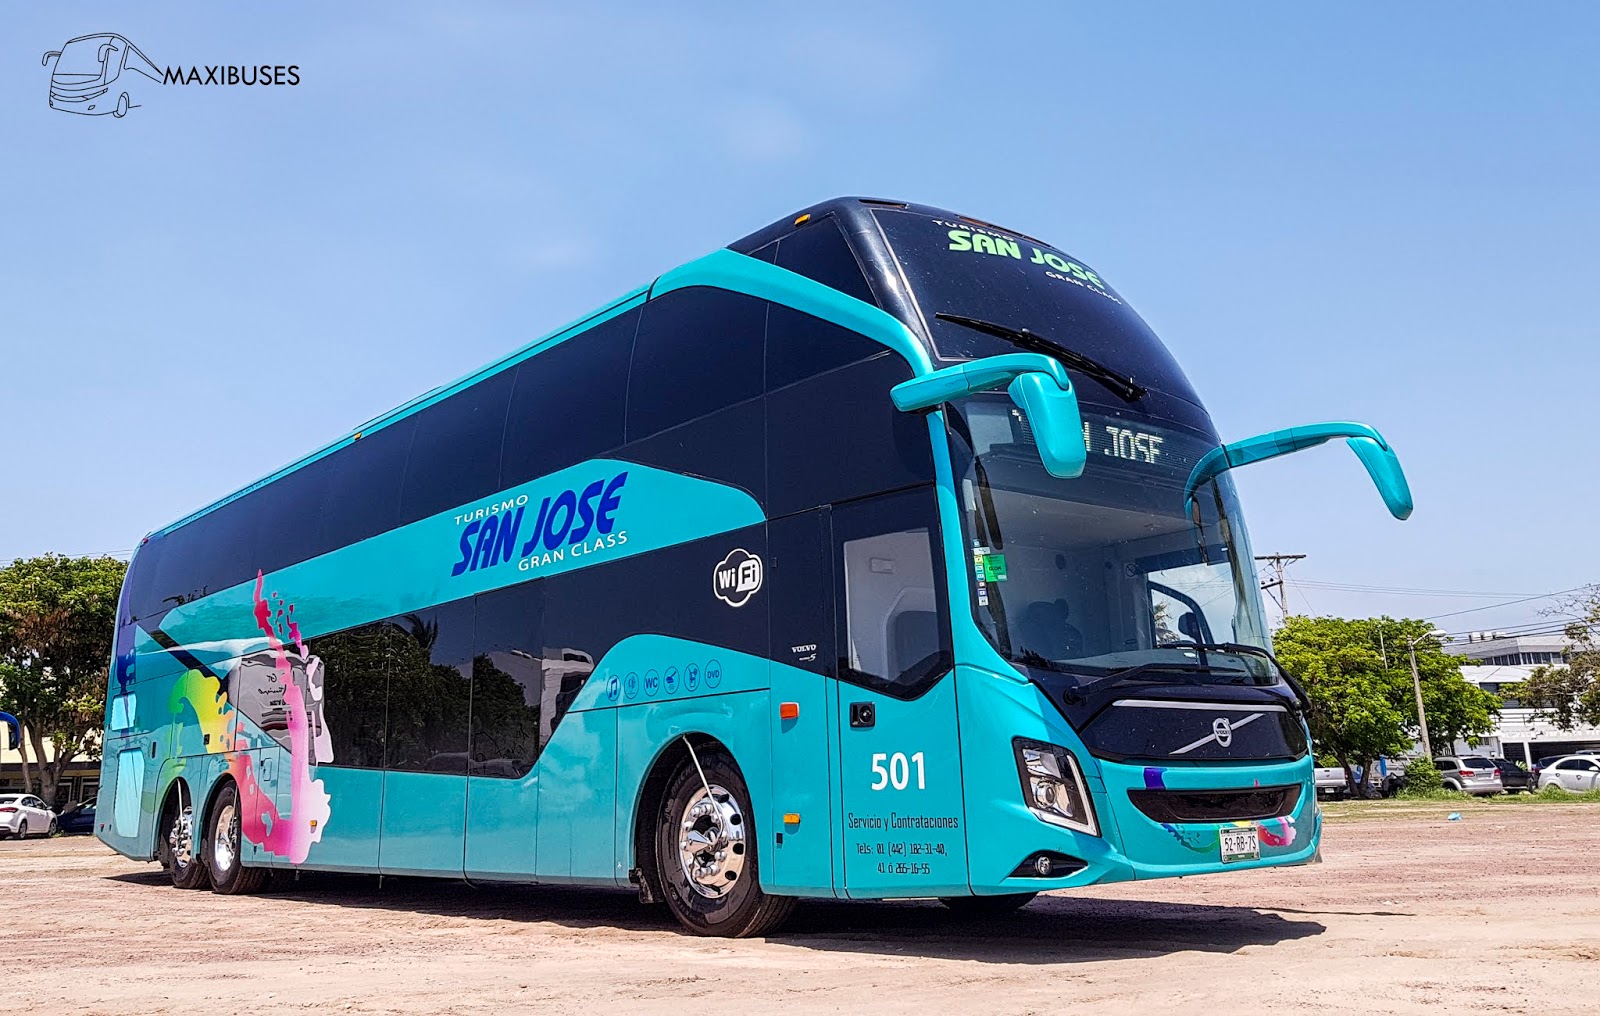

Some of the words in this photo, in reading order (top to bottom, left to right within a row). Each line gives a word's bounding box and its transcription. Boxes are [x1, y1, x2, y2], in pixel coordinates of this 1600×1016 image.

[932, 219, 1015, 242] TURISMO
[948, 229, 1022, 260] SAN
[1030, 247, 1106, 290] JOSE
[1045, 271, 1085, 287] GRAN
[454, 494, 529, 526] TURISMO
[451, 505, 526, 577] SAN
[521, 471, 629, 558] JOSE
[518, 549, 565, 572] GRAN
[570, 530, 628, 557] CLASS
[791, 643, 817, 653] VOLVO
[645, 677, 658, 689] WC
[707, 669, 720, 679] DVD
[871, 751, 926, 791] 501
[848, 812, 882, 829] Servicio
[884, 816, 889, 832] y
[891, 812, 959, 829] Contrataciones
[856, 843, 874, 855] Tels:
[888, 841, 907, 858] (442)
[878, 862, 885, 874] 41
